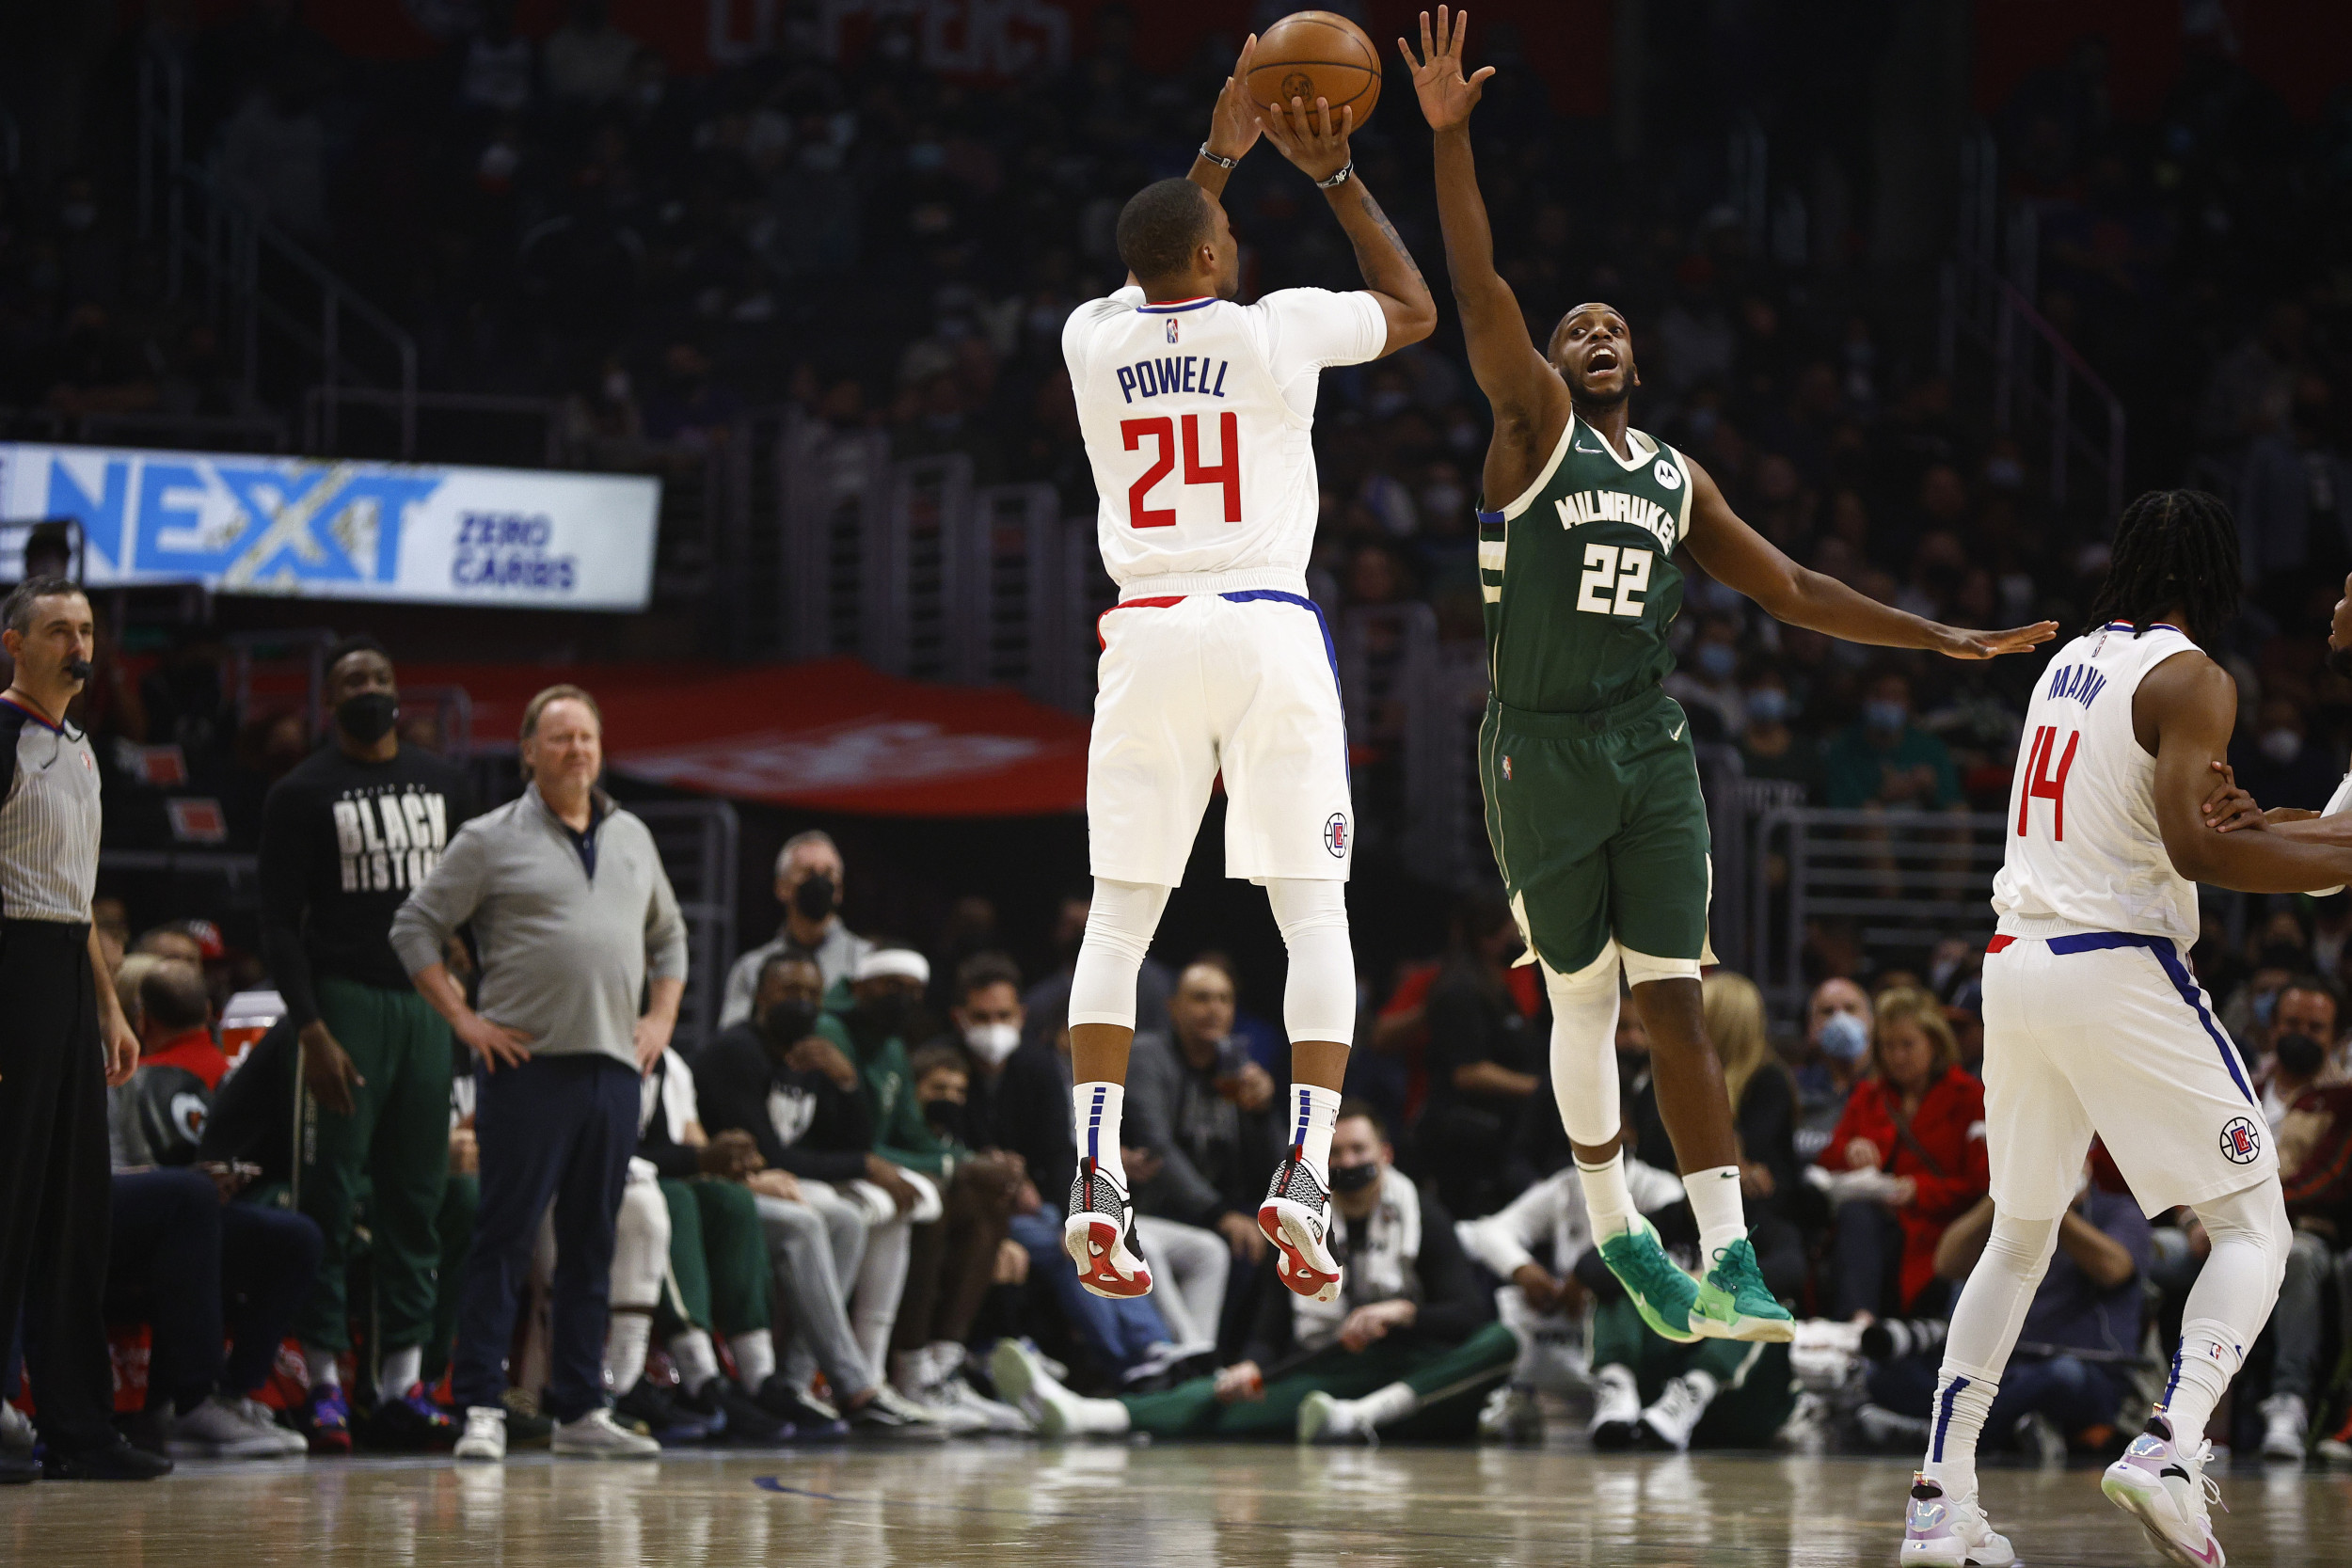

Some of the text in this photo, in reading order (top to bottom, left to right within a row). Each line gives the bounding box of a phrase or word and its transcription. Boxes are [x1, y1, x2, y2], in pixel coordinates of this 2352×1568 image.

[1118, 356, 1229, 404] POWELL
[1120, 412, 1241, 528] 24
[456, 513, 553, 546] ZERO
[1577, 543, 1653, 617] 22
[2047, 664, 2106, 710] MANN
[2018, 726, 2079, 842] 14
[333, 792, 448, 857] BLACK
